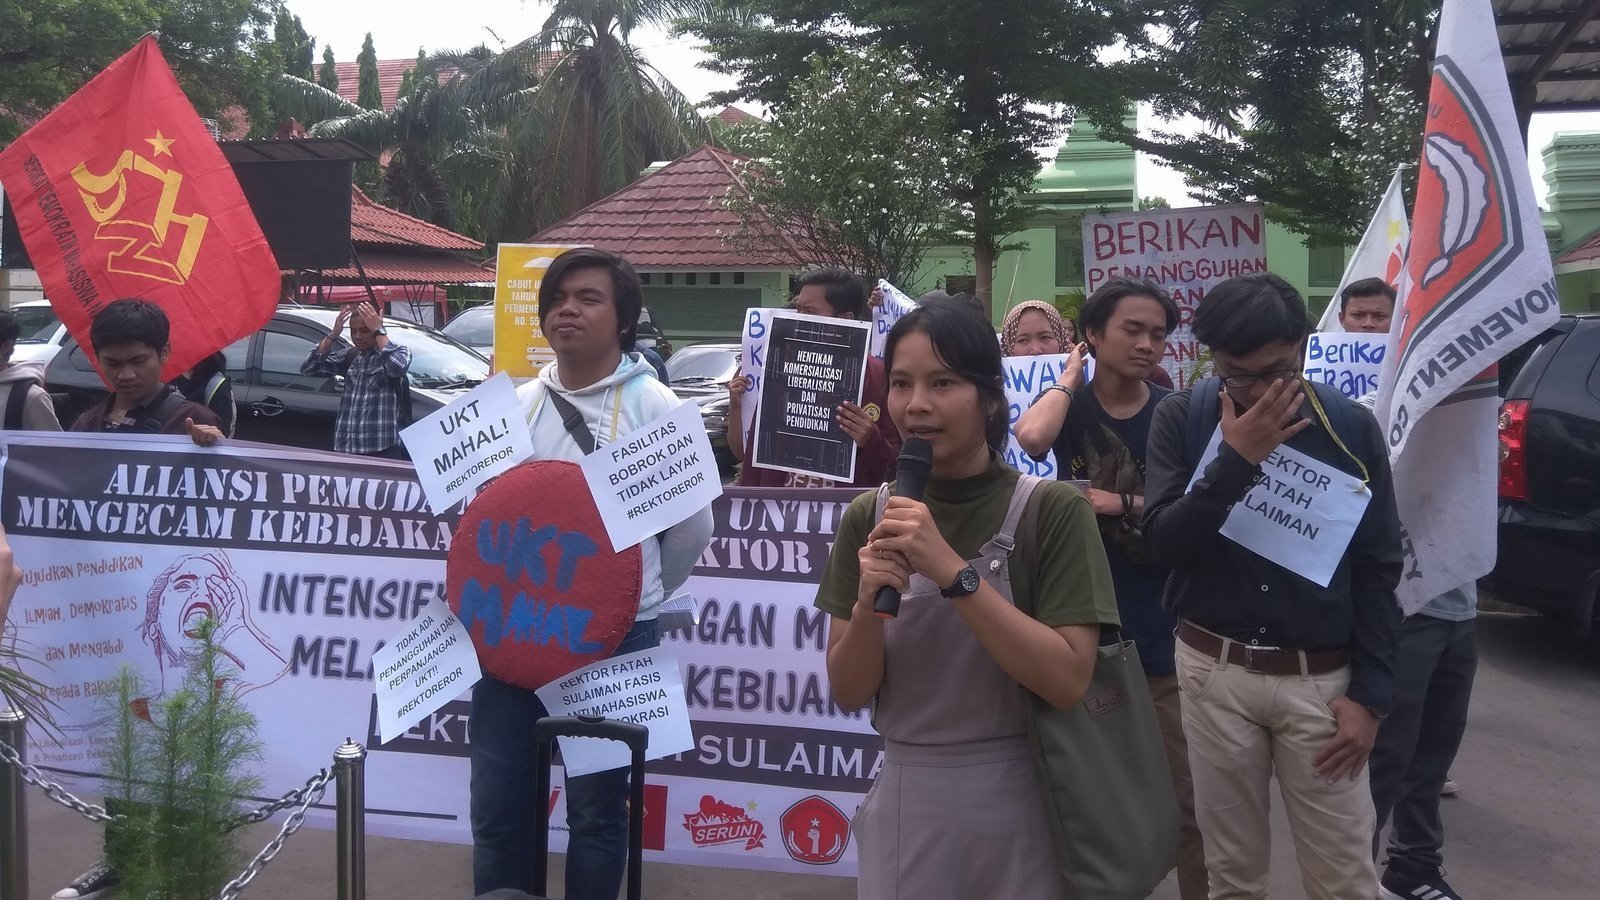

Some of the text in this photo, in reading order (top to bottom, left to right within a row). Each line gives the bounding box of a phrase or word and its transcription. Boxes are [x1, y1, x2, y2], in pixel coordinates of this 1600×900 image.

[1093, 213, 1261, 261] BERIKAN
[507, 279, 532, 289] CABUT
[1088, 257, 1268, 293] PENANGGUHAN
[512, 291, 536, 301] TAHUN
[515, 316, 527, 326] NO.
[783, 361, 843, 381] KOMERSIALISASI
[797, 350, 834, 366] HENTIKAN
[787, 375, 835, 393] LIBERALISASI
[801, 390, 817, 404] DAN
[439, 399, 480, 435] UKT
[785, 415, 830, 433] PENDIDIKAN
[786, 401, 831, 419] PRIVATISASI
[433, 417, 509, 476] MAHAL!
[608, 433, 694, 486] BOBROK DAN
[611, 421, 677, 463] FASILITAS
[103, 463, 268, 503] ALIANSI
[445, 445, 514, 495] #REKTOREROR
[616, 451, 700, 503] TIDAK LAYAK
[626, 472, 705, 520] #REKTOREROR
[16, 496, 236, 540] MENGECAM
[729, 497, 849, 535] UNTI
[1244, 494, 1320, 541] LAIMAN
[477, 517, 598, 592] UKT
[395, 615, 434, 653] TIDAK ADA
[668, 598, 777, 648] GAN
[379, 614, 456, 682] PENANGGUHAN DAN
[389, 633, 457, 690] PERPANJANGAN
[415, 665, 439, 688] UKT!!
[559, 656, 653, 690] REKTOR FATAH
[562, 671, 662, 706] SULAIMAN FASIS
[685, 662, 868, 718] KEBIJA
[397, 666, 463, 719] #REKTOREROR
[591, 688, 668, 718] MAHASISWA
[616, 705, 669, 724] OKRASI
[694, 822, 758, 842] SERUNI
